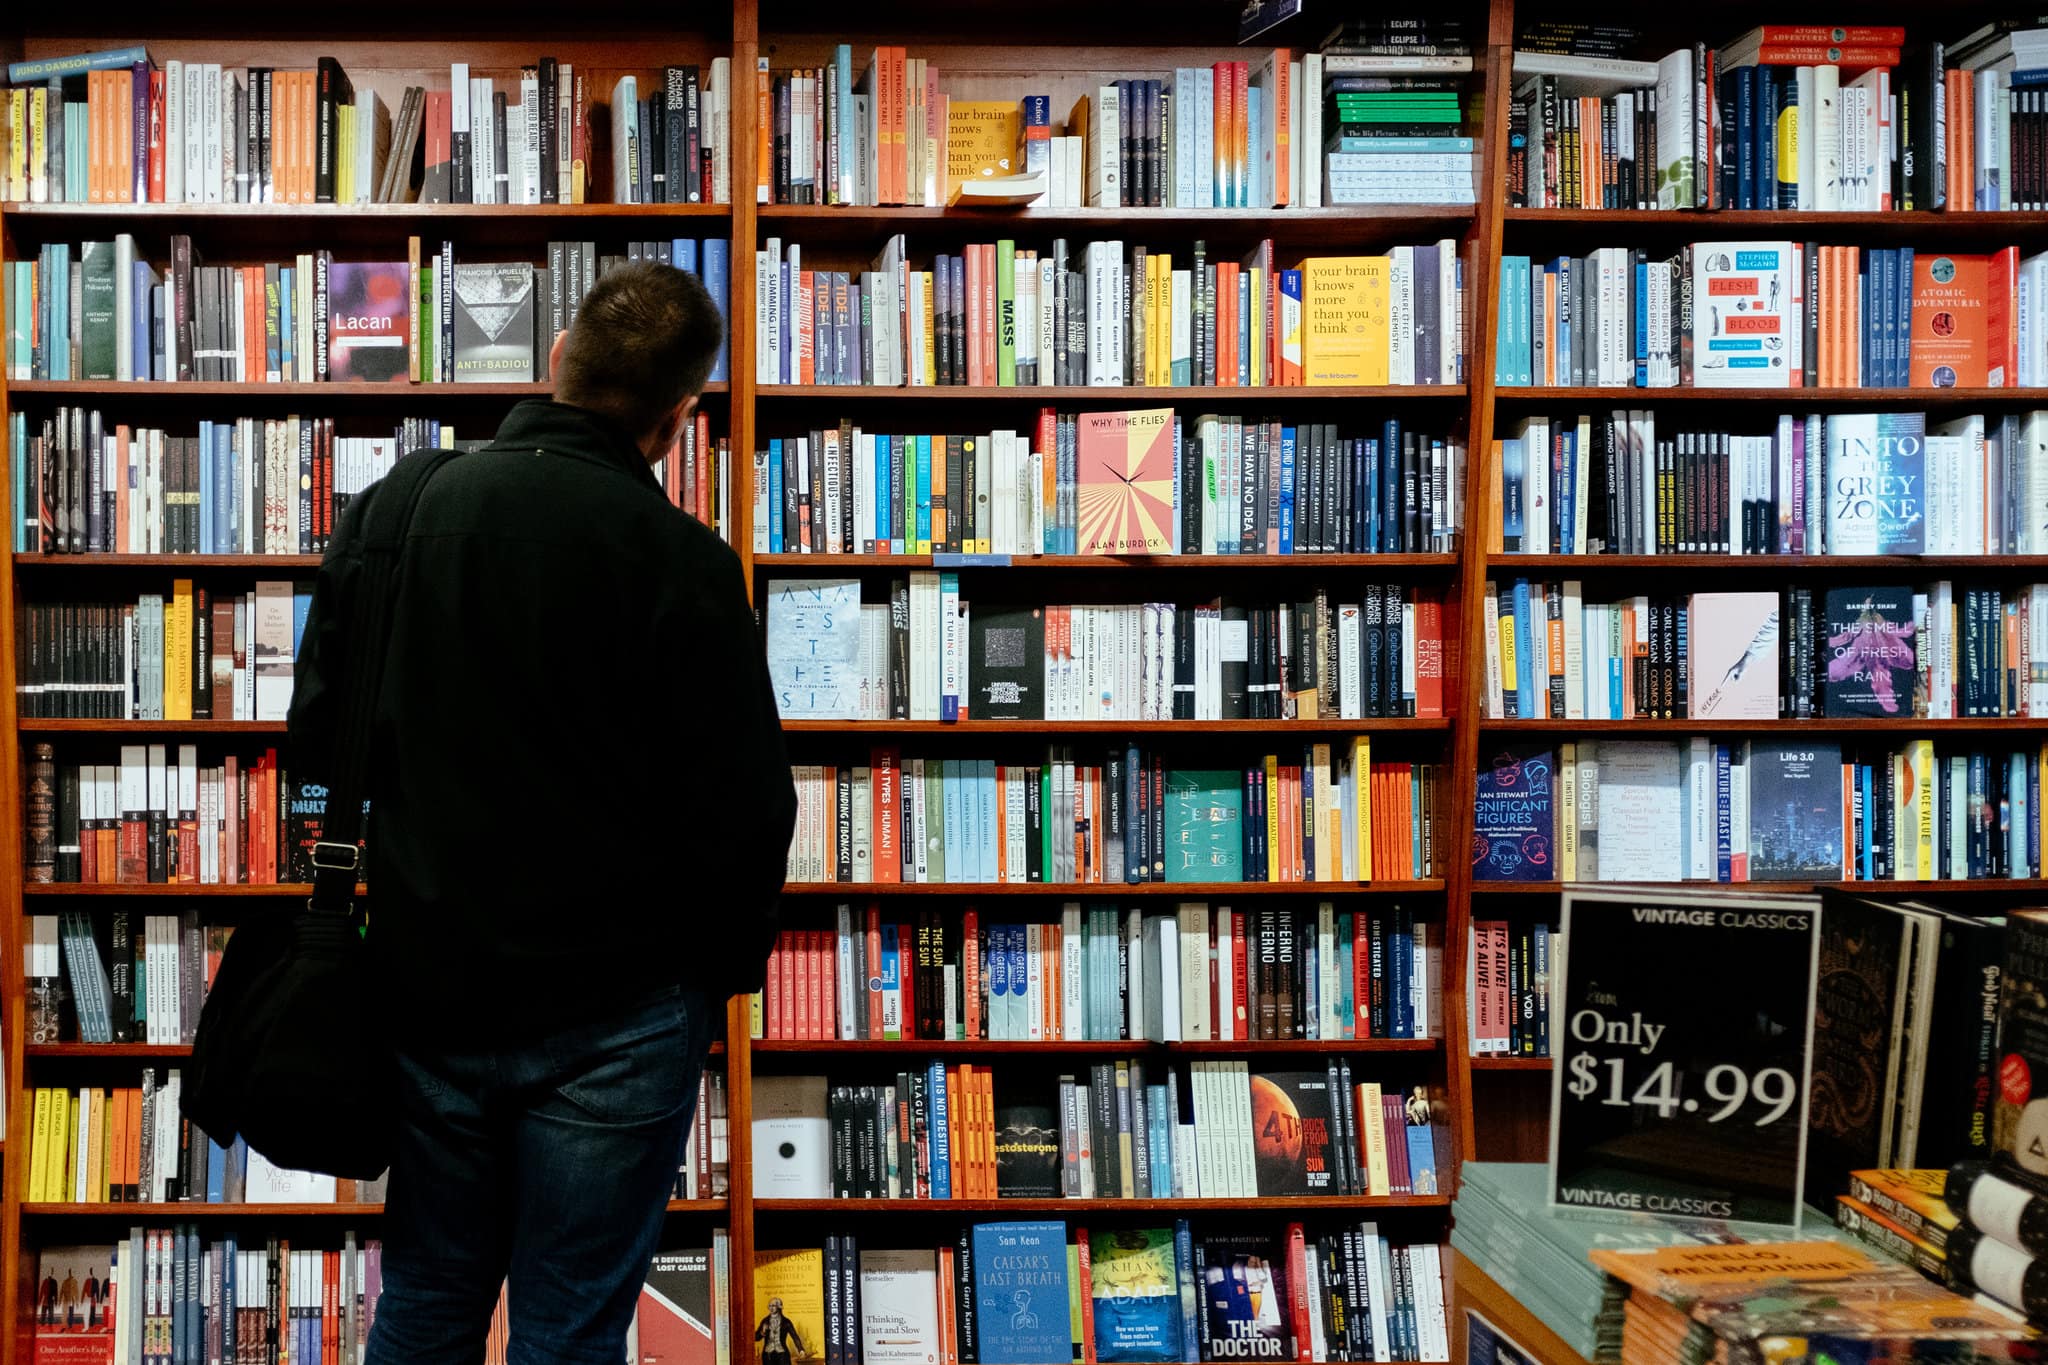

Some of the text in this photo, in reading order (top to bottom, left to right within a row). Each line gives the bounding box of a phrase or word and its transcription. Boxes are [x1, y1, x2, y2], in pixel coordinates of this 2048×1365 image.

[1390, 19, 1418, 29] ECLIPSE
[15, 57, 90, 77] JUNO DAWSON
[667, 68, 676, 111] DAWKINS
[675, 69, 683, 110] RICHARD
[688, 84, 696, 129] EVERYDAY ETHICS
[973, 109, 1005, 120] brain
[1035, 97, 1043, 124] Oxford
[1544, 85, 1554, 135] PLAGUE
[528, 88, 537, 153] REQUIRED READING
[1789, 113, 1798, 153] COSMOS
[1845, 90, 1855, 178] CATCHING BREATH
[1904, 151, 1914, 177] VOID
[1312, 264, 1379, 279] your brain
[1147, 277, 1157, 308] Sound
[1314, 279, 1355, 291] knows
[1562, 271, 1570, 323] DRIVERLESS
[1712, 279, 1754, 291] FLESH
[818, 283, 829, 312] TIDE
[1314, 295, 1346, 305] more
[1681, 276, 1693, 330] VISIONEERS
[317, 258, 327, 374] CARPE DIEM REGAINED
[335, 313, 392, 330] Lacan
[1002, 299, 1014, 348] MASS
[1042, 304, 1052, 351] PHYSICS
[1314, 309, 1370, 322] than you
[1729, 318, 1778, 330] BLOOD
[1314, 322, 1348, 334] think
[1390, 305, 1399, 353] CHEMISTRY
[456, 358, 530, 371] ANTI-BADIOU
[1091, 416, 1165, 428] WHY TIME FLIES
[1840, 436, 1920, 457] INTO
[826, 445, 840, 500] INFECTIOUS
[892, 448, 901, 500] Universe
[1282, 439, 1293, 494] BEYOND INFINITY
[1858, 459, 1892, 472] THE
[1244, 434, 1254, 531] WE HAVE NO IDEA
[1794, 458, 1802, 522] PROBABILITIES
[1837, 475, 1916, 497] GREY
[1837, 499, 1916, 520] ZONE
[1089, 539, 1160, 551] ALAN BURDICK
[893, 601, 904, 629] KISS
[1650, 607, 1658, 629] CARL
[1677, 610, 1687, 656] PANDEMIC
[1831, 622, 1914, 634] THE SMELL
[946, 599, 955, 689] THE TURING GUIDE
[1650, 633, 1658, 663] SAGAN
[1834, 647, 1908, 658] OF FRESH
[1917, 633, 1927, 671] INVADERS
[1418, 640, 1429, 679] GENE
[1429, 639, 1438, 679] SELFISH
[1853, 671, 1890, 682] RAIN
[1780, 753, 1815, 761] Life 3.0
[881, 756, 891, 848] TEN TYPES HUMAN
[1474, 801, 1548, 812] GNIFICANT
[1495, 791, 1529, 799] STEWART
[1581, 769, 1593, 825] Biologist
[1718, 763, 1730, 841] NATURE BEAST
[839, 782, 849, 865] FINDING FIBONACCI
[1477, 812, 1532, 823] FIGURES
[1921, 783, 1932, 840] FACE VALUE
[1633, 909, 1809, 931] VINTAGE CLASSICS
[919, 927, 929, 967] THE SUN
[1261, 911, 1275, 964] INFERNO
[1372, 919, 1381, 979] DOMESTICATED
[1477, 928, 1488, 949] IT'S
[996, 932, 1006, 986] BRIAN GREENE
[1477, 951, 1489, 989] ALIVE!
[1571, 1010, 1666, 1054] Only
[914, 1077, 924, 1124] PLAGUE
[1568, 1052, 1796, 1126] $14.99
[935, 1062, 949, 1161] DNA IS NOT DESTINY
[1263, 1110, 1326, 1143] 4TH ROCK
[1304, 1132, 1329, 1145] FROM
[994, 1141, 1059, 1153] estosterone
[1306, 1158, 1325, 1172] SUN
[270, 1178, 292, 1193] life
[1562, 1188, 1732, 1217] VINTAGE CLASSICS
[998, 1235, 1040, 1246] Sam Kean
[660, 1256, 693, 1264] DEFENSE
[677, 1264, 707, 1272] CAUSES
[993, 1256, 1050, 1269] CAESAR'S
[1111, 1261, 1154, 1273] KHAN
[1680, 1251, 1793, 1262] HELLO,
[176, 1258, 185, 1305] HYPATIA
[864, 1267, 876, 1275] The
[864, 1275, 895, 1283] Bestseller
[982, 1272, 1062, 1286] LAST BREATH
[830, 1269, 839, 1345] STRANGE GLOW
[1098, 1286, 1170, 1305] ADAPT
[865, 1314, 906, 1326] Thinking,
[865, 1325, 920, 1335] Fast and Slow
[1227, 1320, 1262, 1337] THE
[866, 1350, 922, 1358] Daniel Kahneman
[1211, 1338, 1282, 1356] DOCTOR
